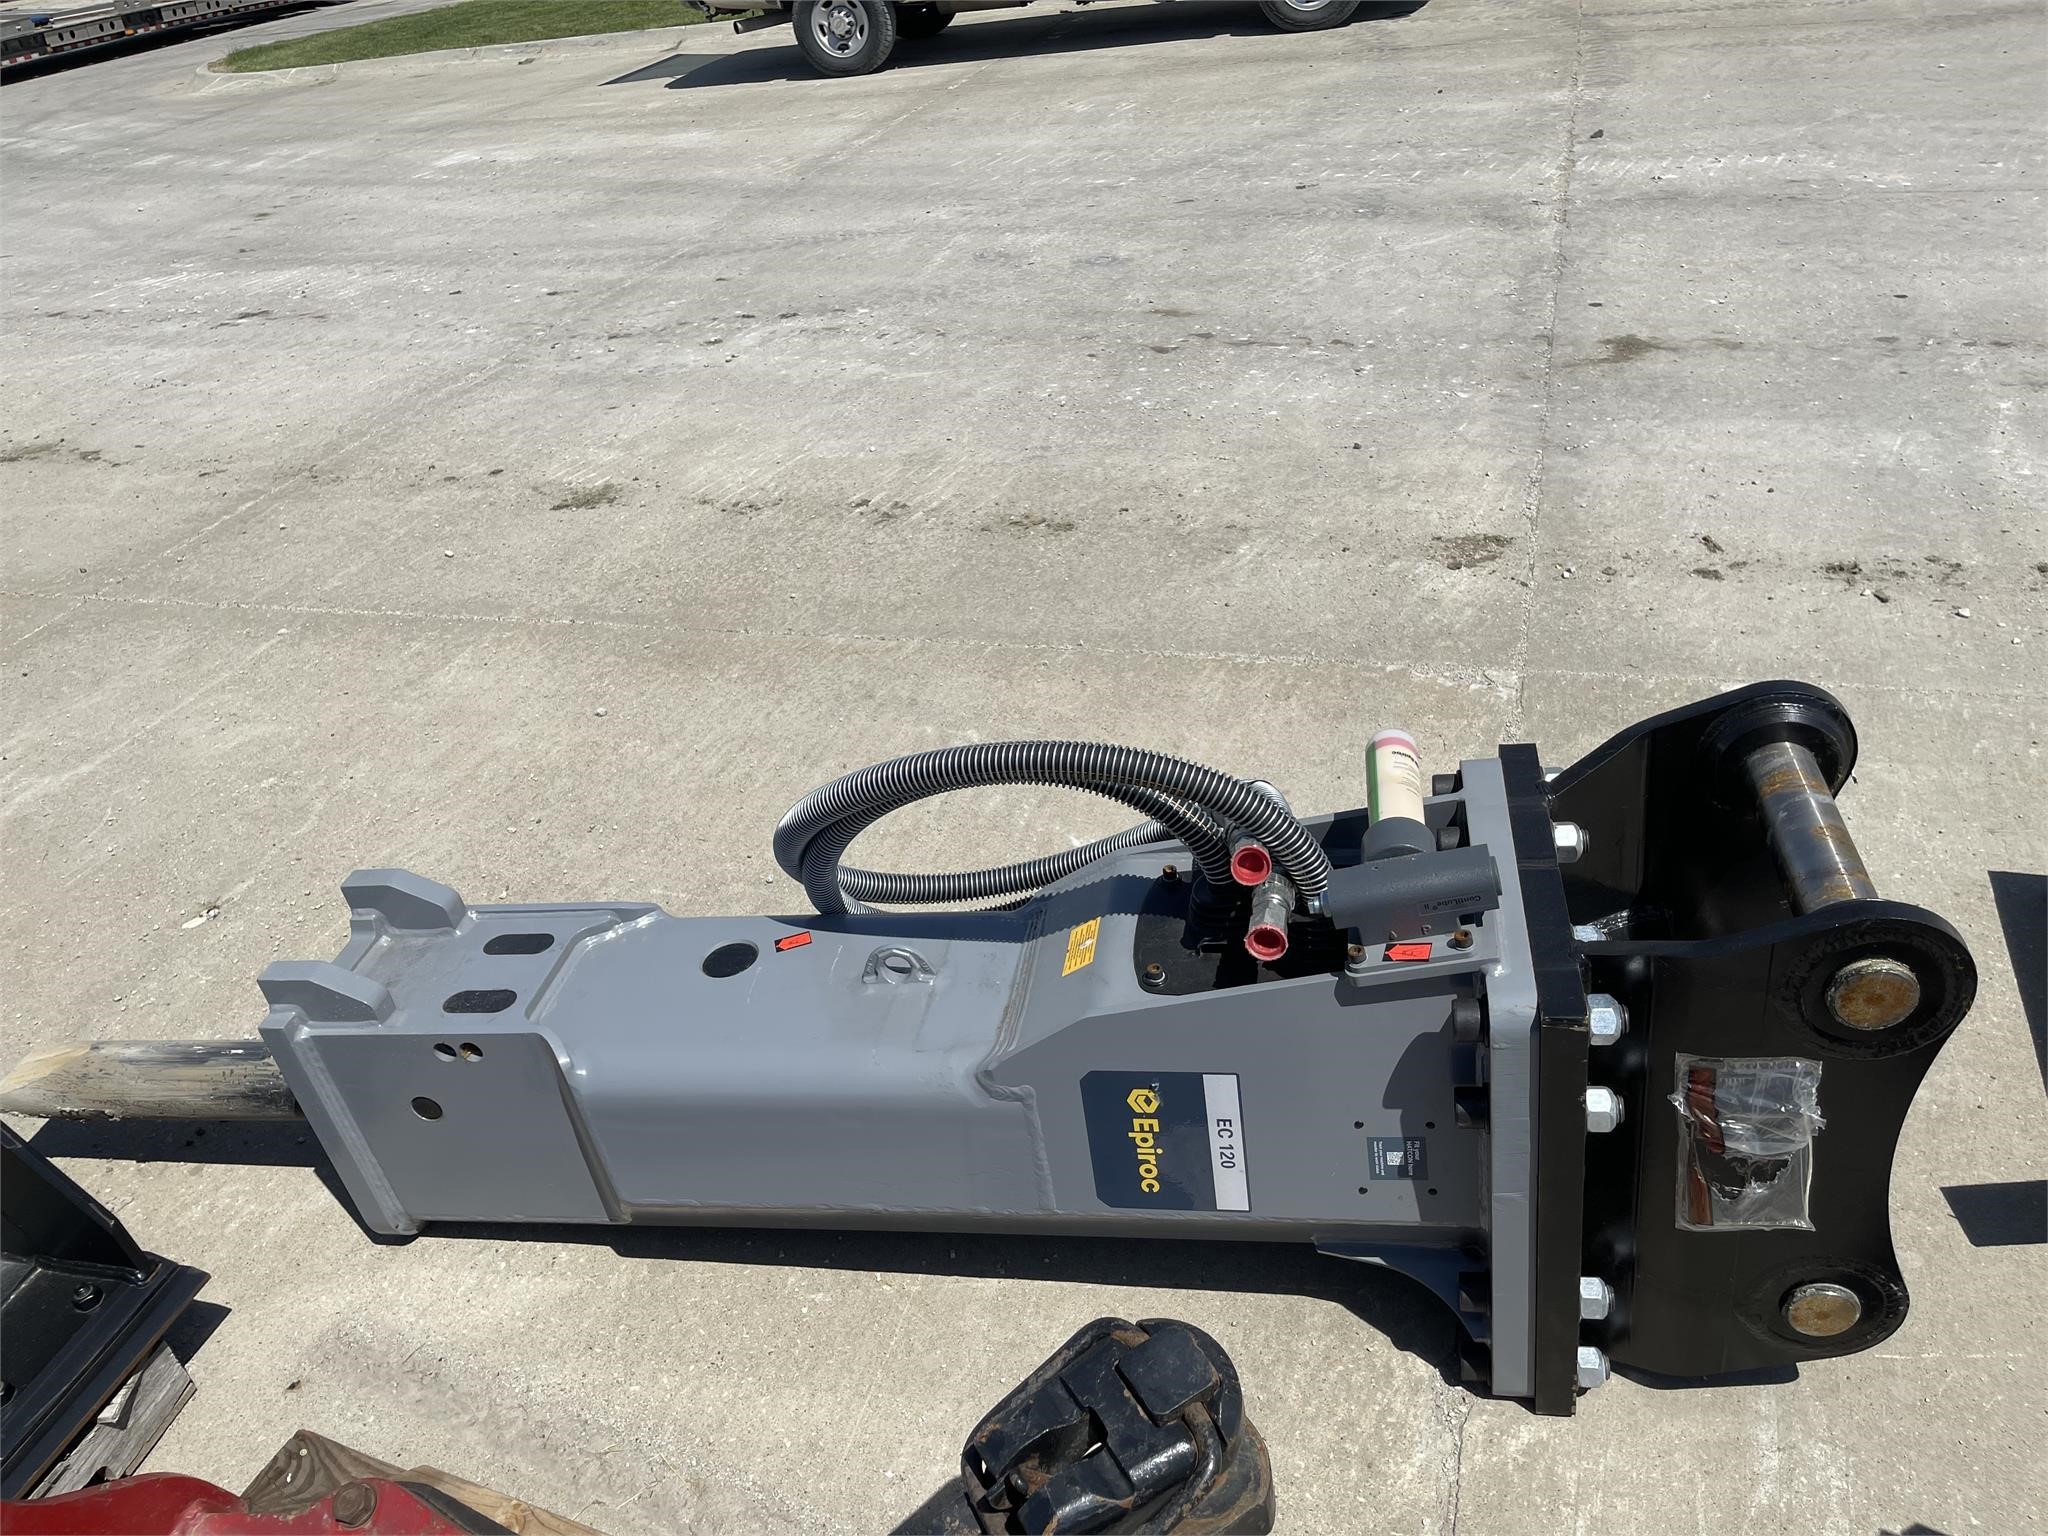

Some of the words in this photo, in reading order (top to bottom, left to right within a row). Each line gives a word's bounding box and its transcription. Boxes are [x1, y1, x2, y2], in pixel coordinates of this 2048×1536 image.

[1216, 1118, 1234, 1139] EC
[1128, 1118, 1164, 1193] Epiroc
[1218, 1144, 1236, 1169] 120
